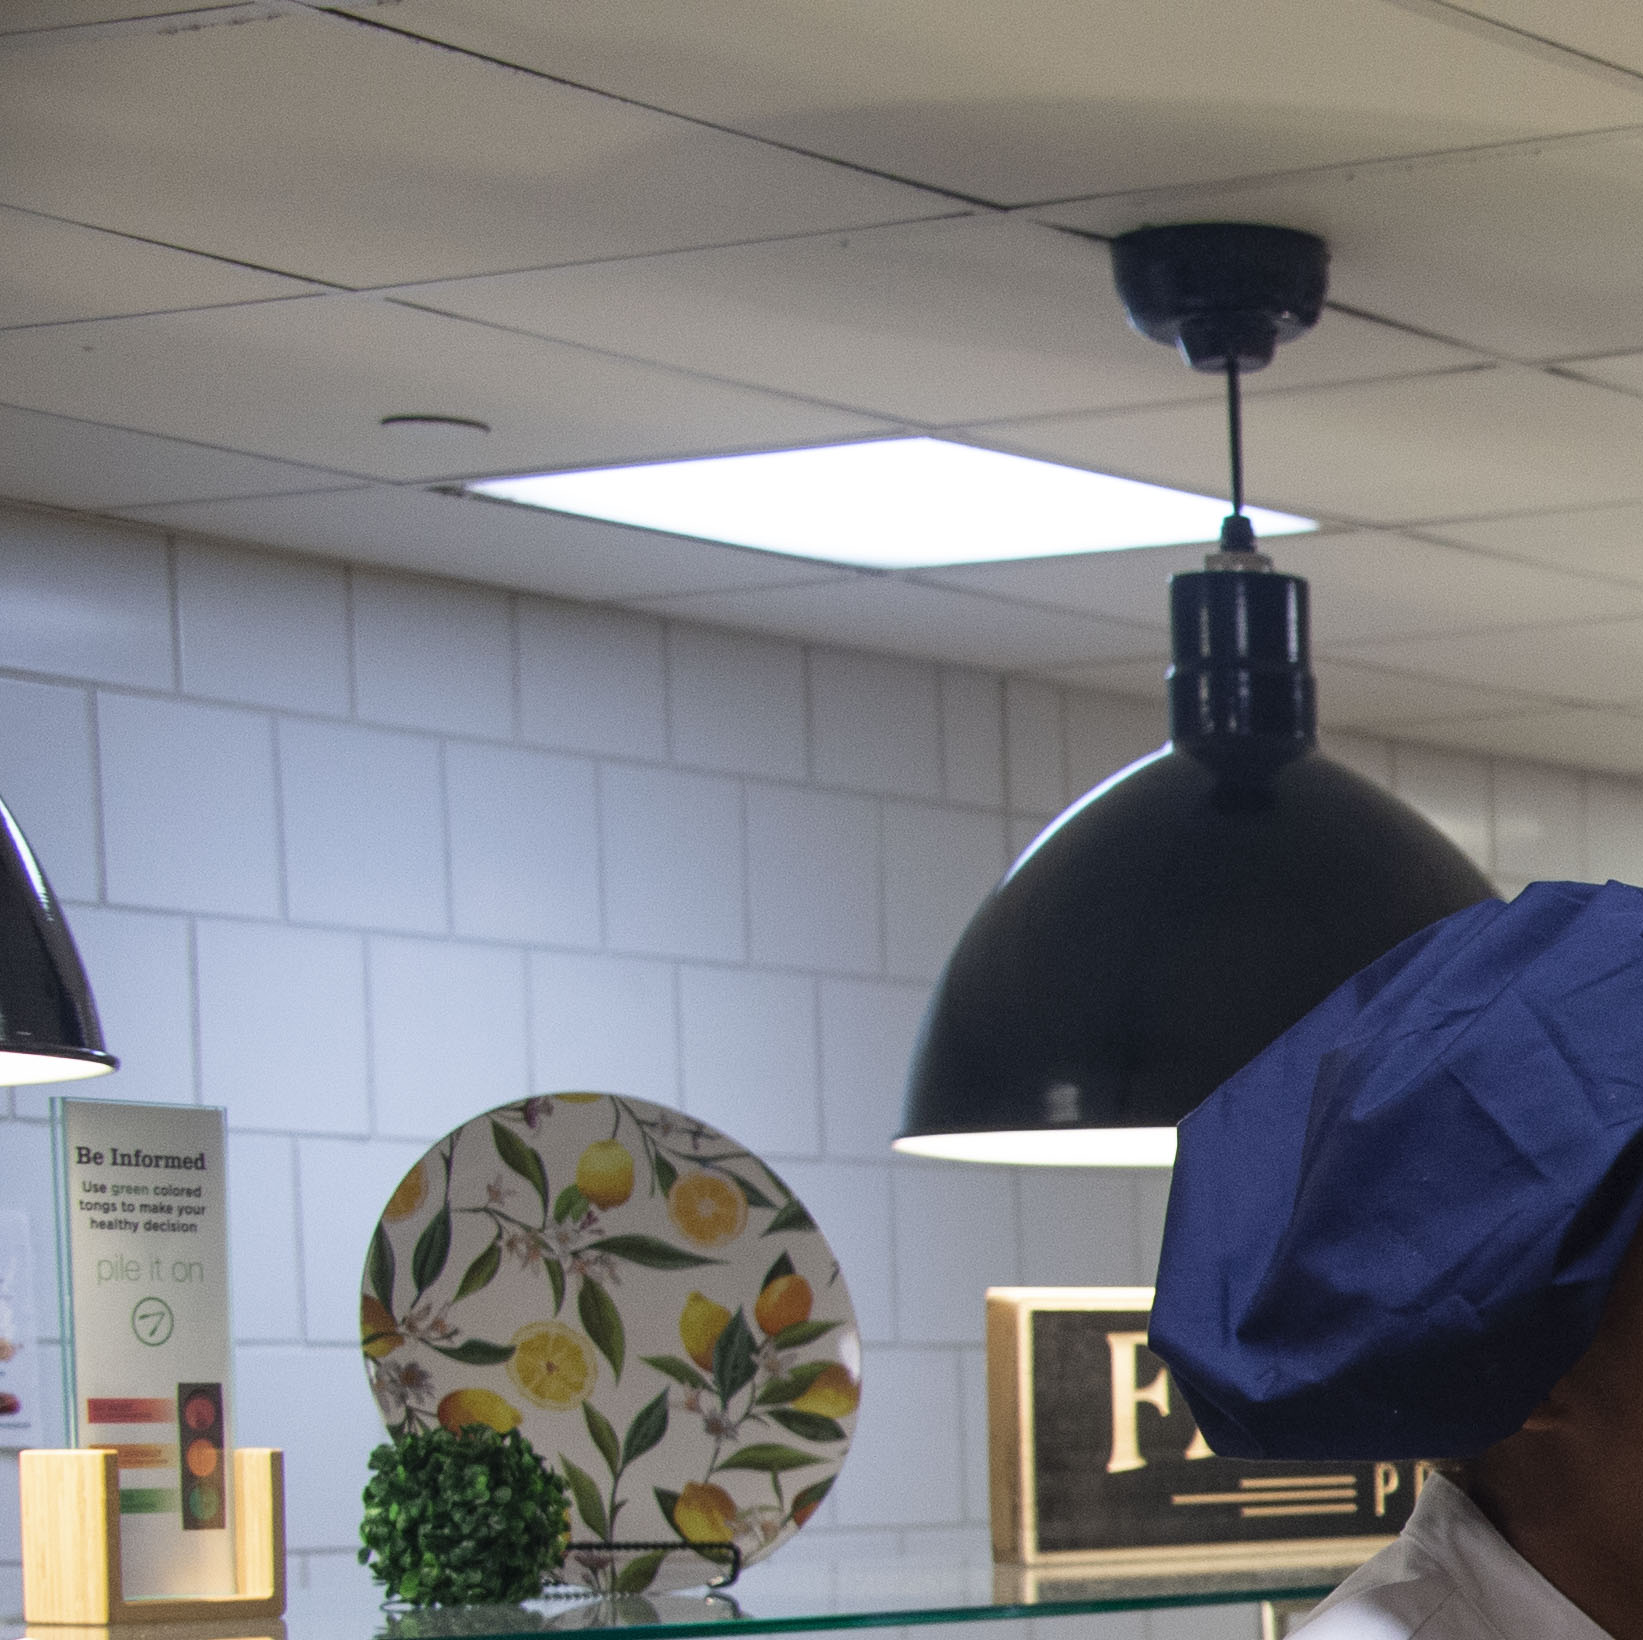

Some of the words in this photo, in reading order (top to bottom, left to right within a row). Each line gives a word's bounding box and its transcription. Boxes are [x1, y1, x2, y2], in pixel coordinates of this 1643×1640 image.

[76, 1146, 104, 1166] Be
[111, 1147, 207, 1171] Informed
[82, 1181, 108, 1194] Use
[111, 1184, 149, 1197] green
[153, 1185, 203, 1198] colored
[79, 1200, 118, 1214] tongs
[121, 1201, 136, 1213] to
[139, 1202, 174, 1215] make
[177, 1205, 206, 1218] your
[90, 1217, 140, 1233] healthy
[143, 1219, 198, 1233] decision
[96, 1253, 140, 1286] pile
[149, 1257, 162, 1282] it
[172, 1260, 205, 1283] on
